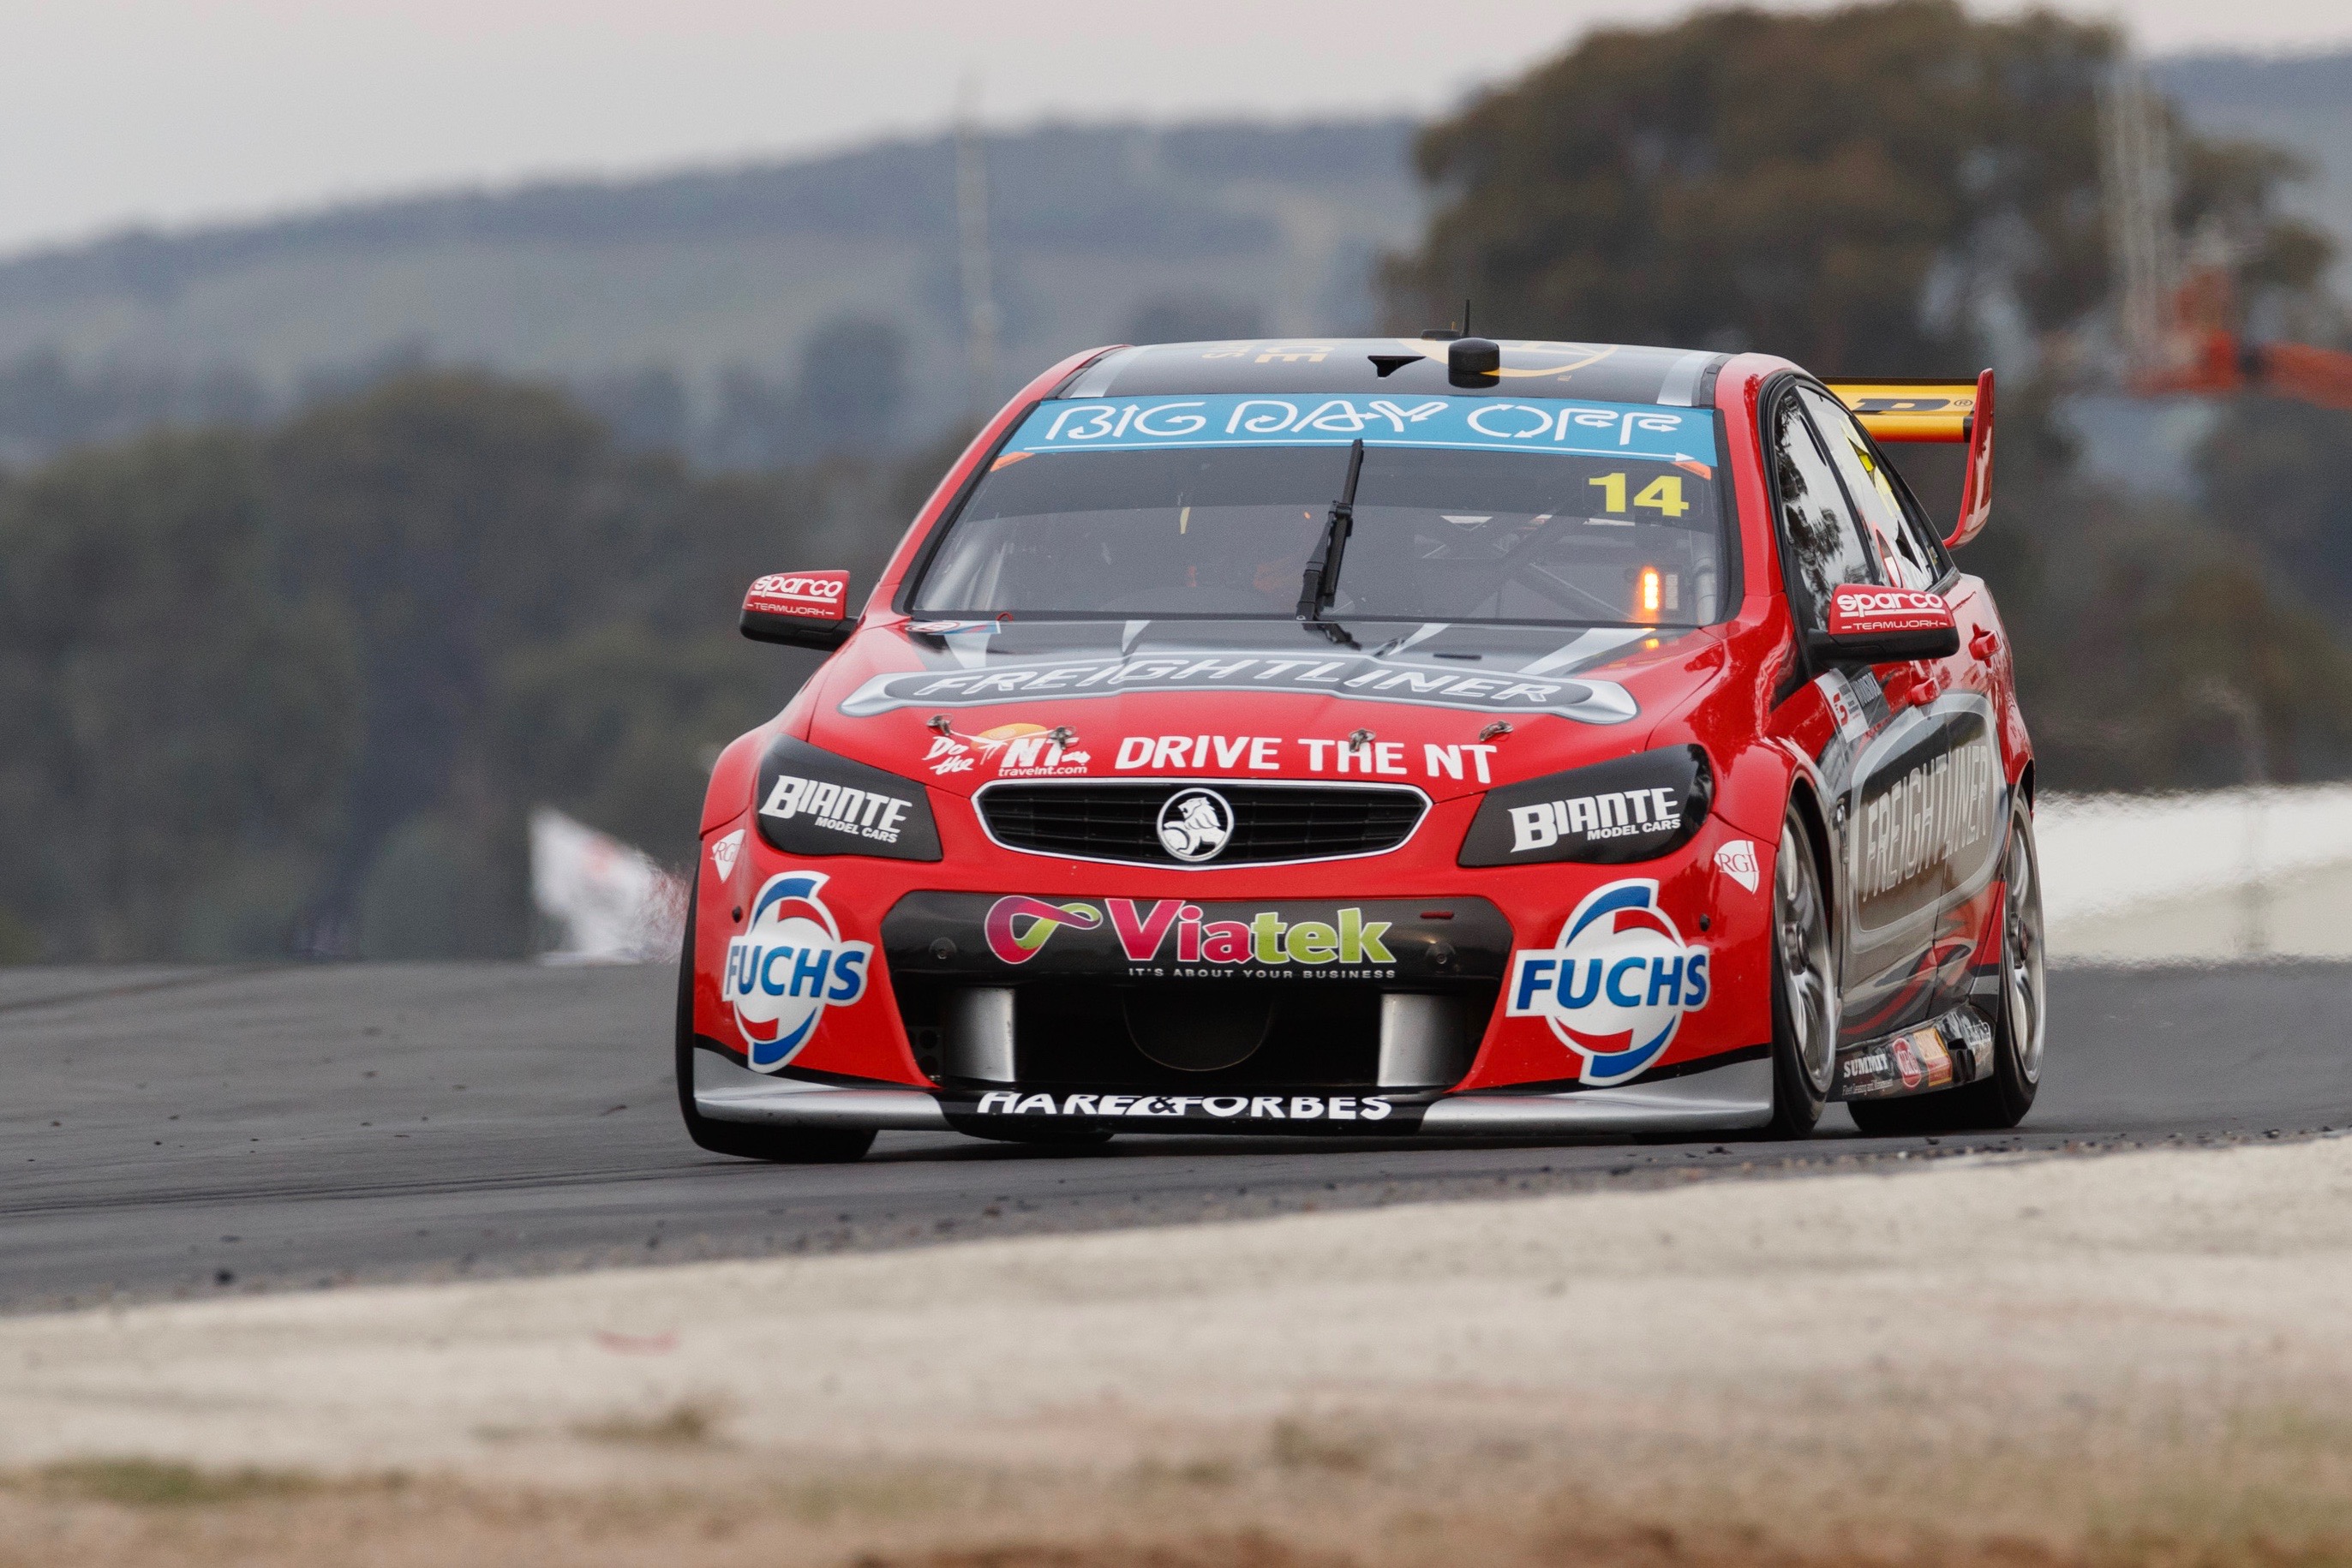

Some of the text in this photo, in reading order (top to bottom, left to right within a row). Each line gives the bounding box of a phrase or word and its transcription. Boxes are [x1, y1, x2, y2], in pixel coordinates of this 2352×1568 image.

[1044, 401, 1207, 440] BIG
[1224, 399, 1449, 434] DAY
[1588, 471, 1690, 518] 14
[754, 575, 844, 598] sparco
[753, 601, 826, 616] TEAMWORK
[1836, 592, 1944, 618] sparco
[1852, 619, 1939, 631] TEAMWORK
[913, 658, 1562, 703] FREIGHTLINER
[921, 736, 970, 761] Do
[930, 737, 1080, 775] the NT
[1114, 734, 1498, 784] DRIVE THE NT
[998, 764, 1088, 778] travelnt.com
[758, 775, 913, 834] BIANTE
[1506, 787, 1681, 853] BIANTE
[814, 815, 899, 844] MODEL CARS
[1587, 817, 1682, 841] MODEL CARS
[1862, 745, 1989, 903] FREIGHTLINER
[1716, 853, 1760, 873] RGI
[1104, 897, 1397, 965] Viatek
[725, 944, 865, 1002] FUCHS
[1128, 967, 1396, 979] IT'S ABOUT YOUR BUSINESS
[1515, 949, 1709, 1011] FUCHS
[1843, 1053, 1888, 1078] SUMMIT
